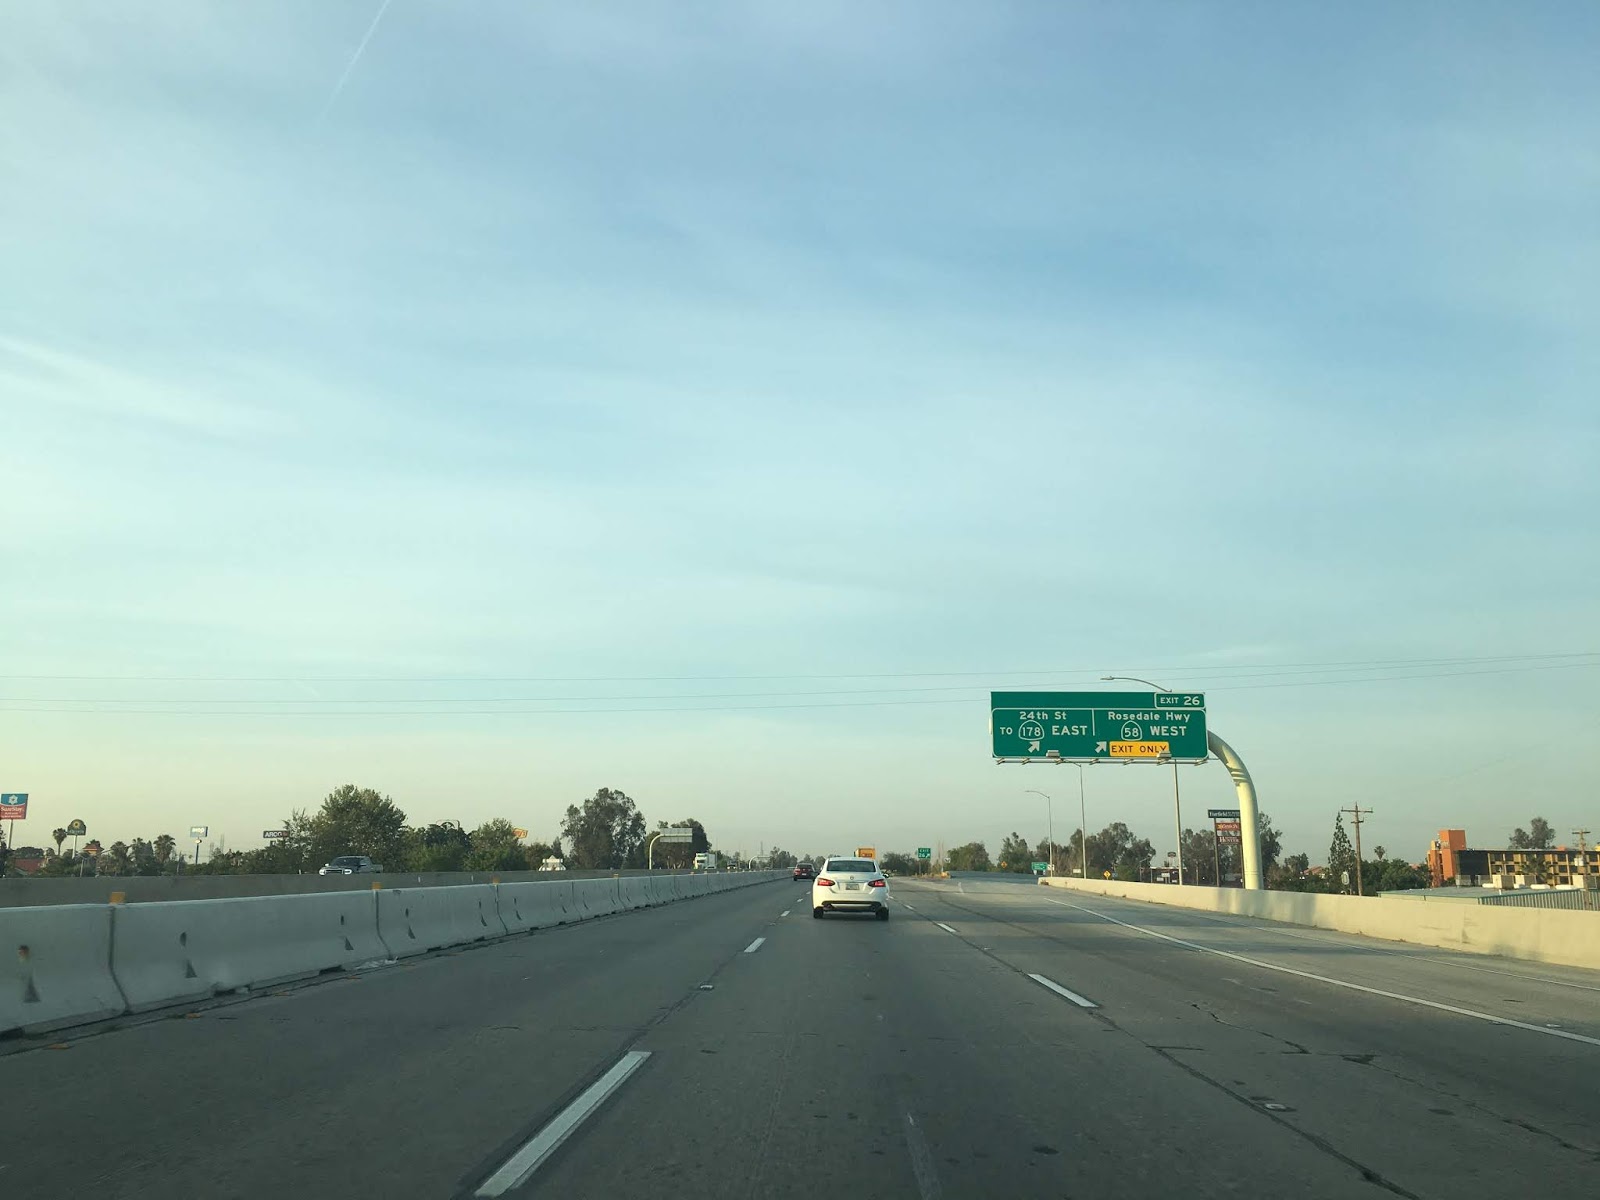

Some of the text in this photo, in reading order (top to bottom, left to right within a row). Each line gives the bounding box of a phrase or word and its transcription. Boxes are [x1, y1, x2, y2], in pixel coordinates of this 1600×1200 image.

[1183, 696, 1200, 706] 26
[1019, 711, 1067, 720] 24th St
[1108, 712, 1190, 722] Rosedale Hwy
[999, 725, 1087, 737] TO 178 EAST
[1124, 725, 1187, 738] 58 WEST
[1111, 745, 1167, 753] EXIT ONLY
